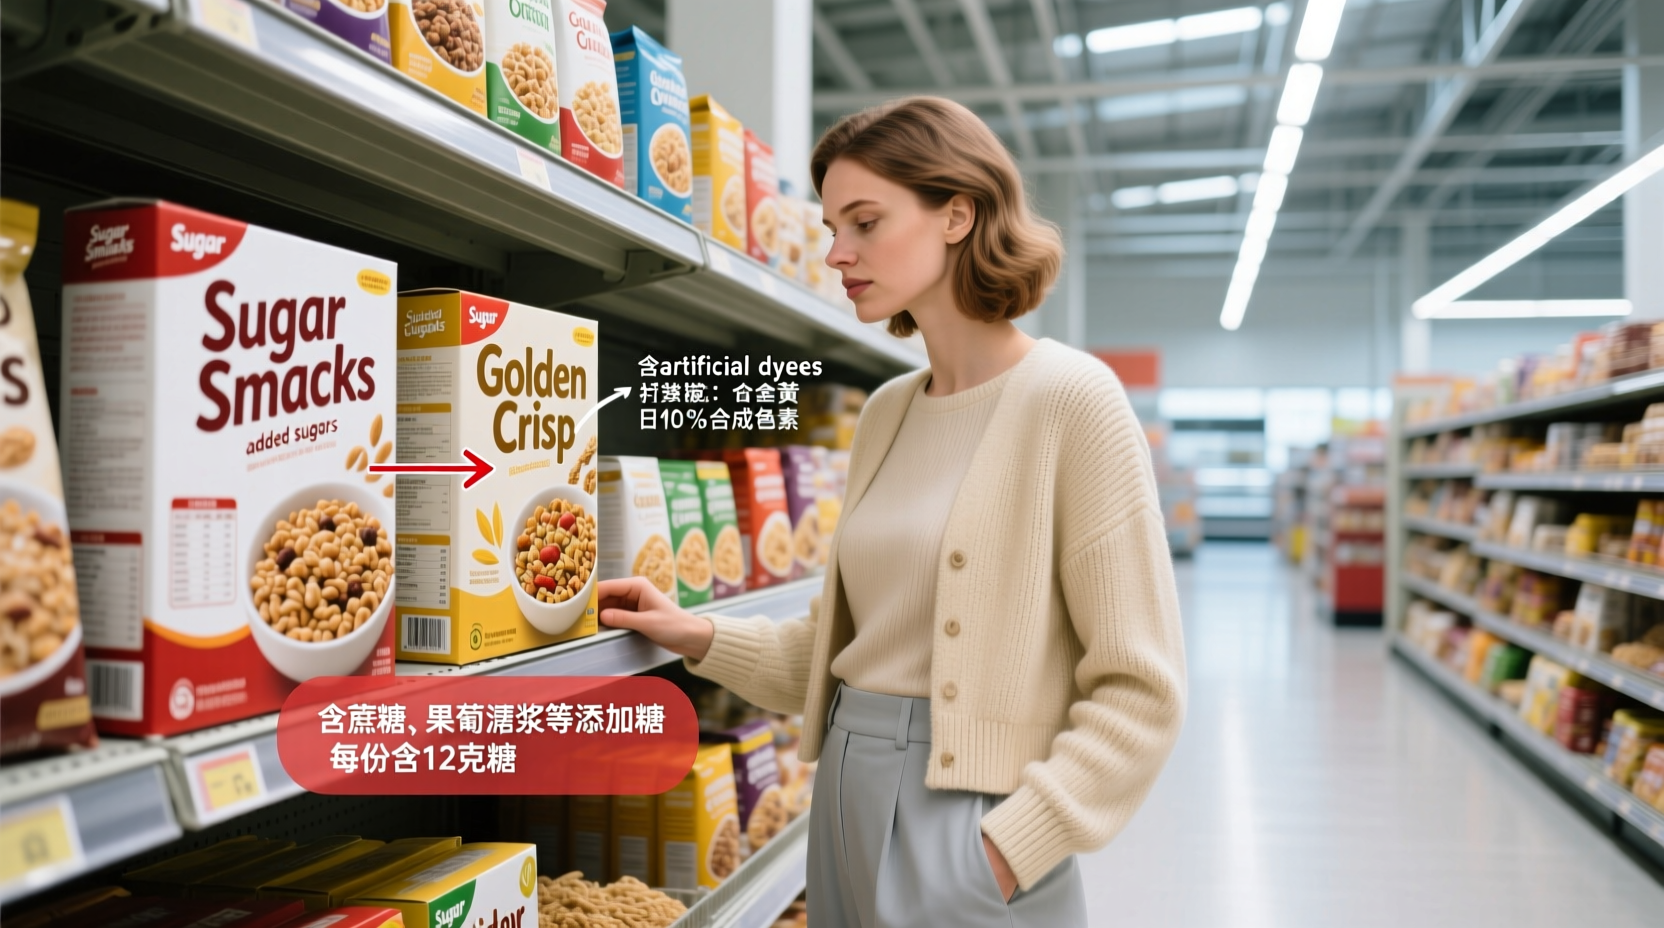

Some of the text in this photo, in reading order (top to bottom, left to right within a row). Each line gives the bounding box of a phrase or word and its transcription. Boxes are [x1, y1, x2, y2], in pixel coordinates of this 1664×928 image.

[170, 222, 227, 260] Sugar
[202, 280, 346, 363] Sugar
[196, 343, 375, 432] Smacks
[476, 343, 587, 400] Golden
[246, 419, 338, 455] added sugars
[492, 400, 576, 464] Crisp
